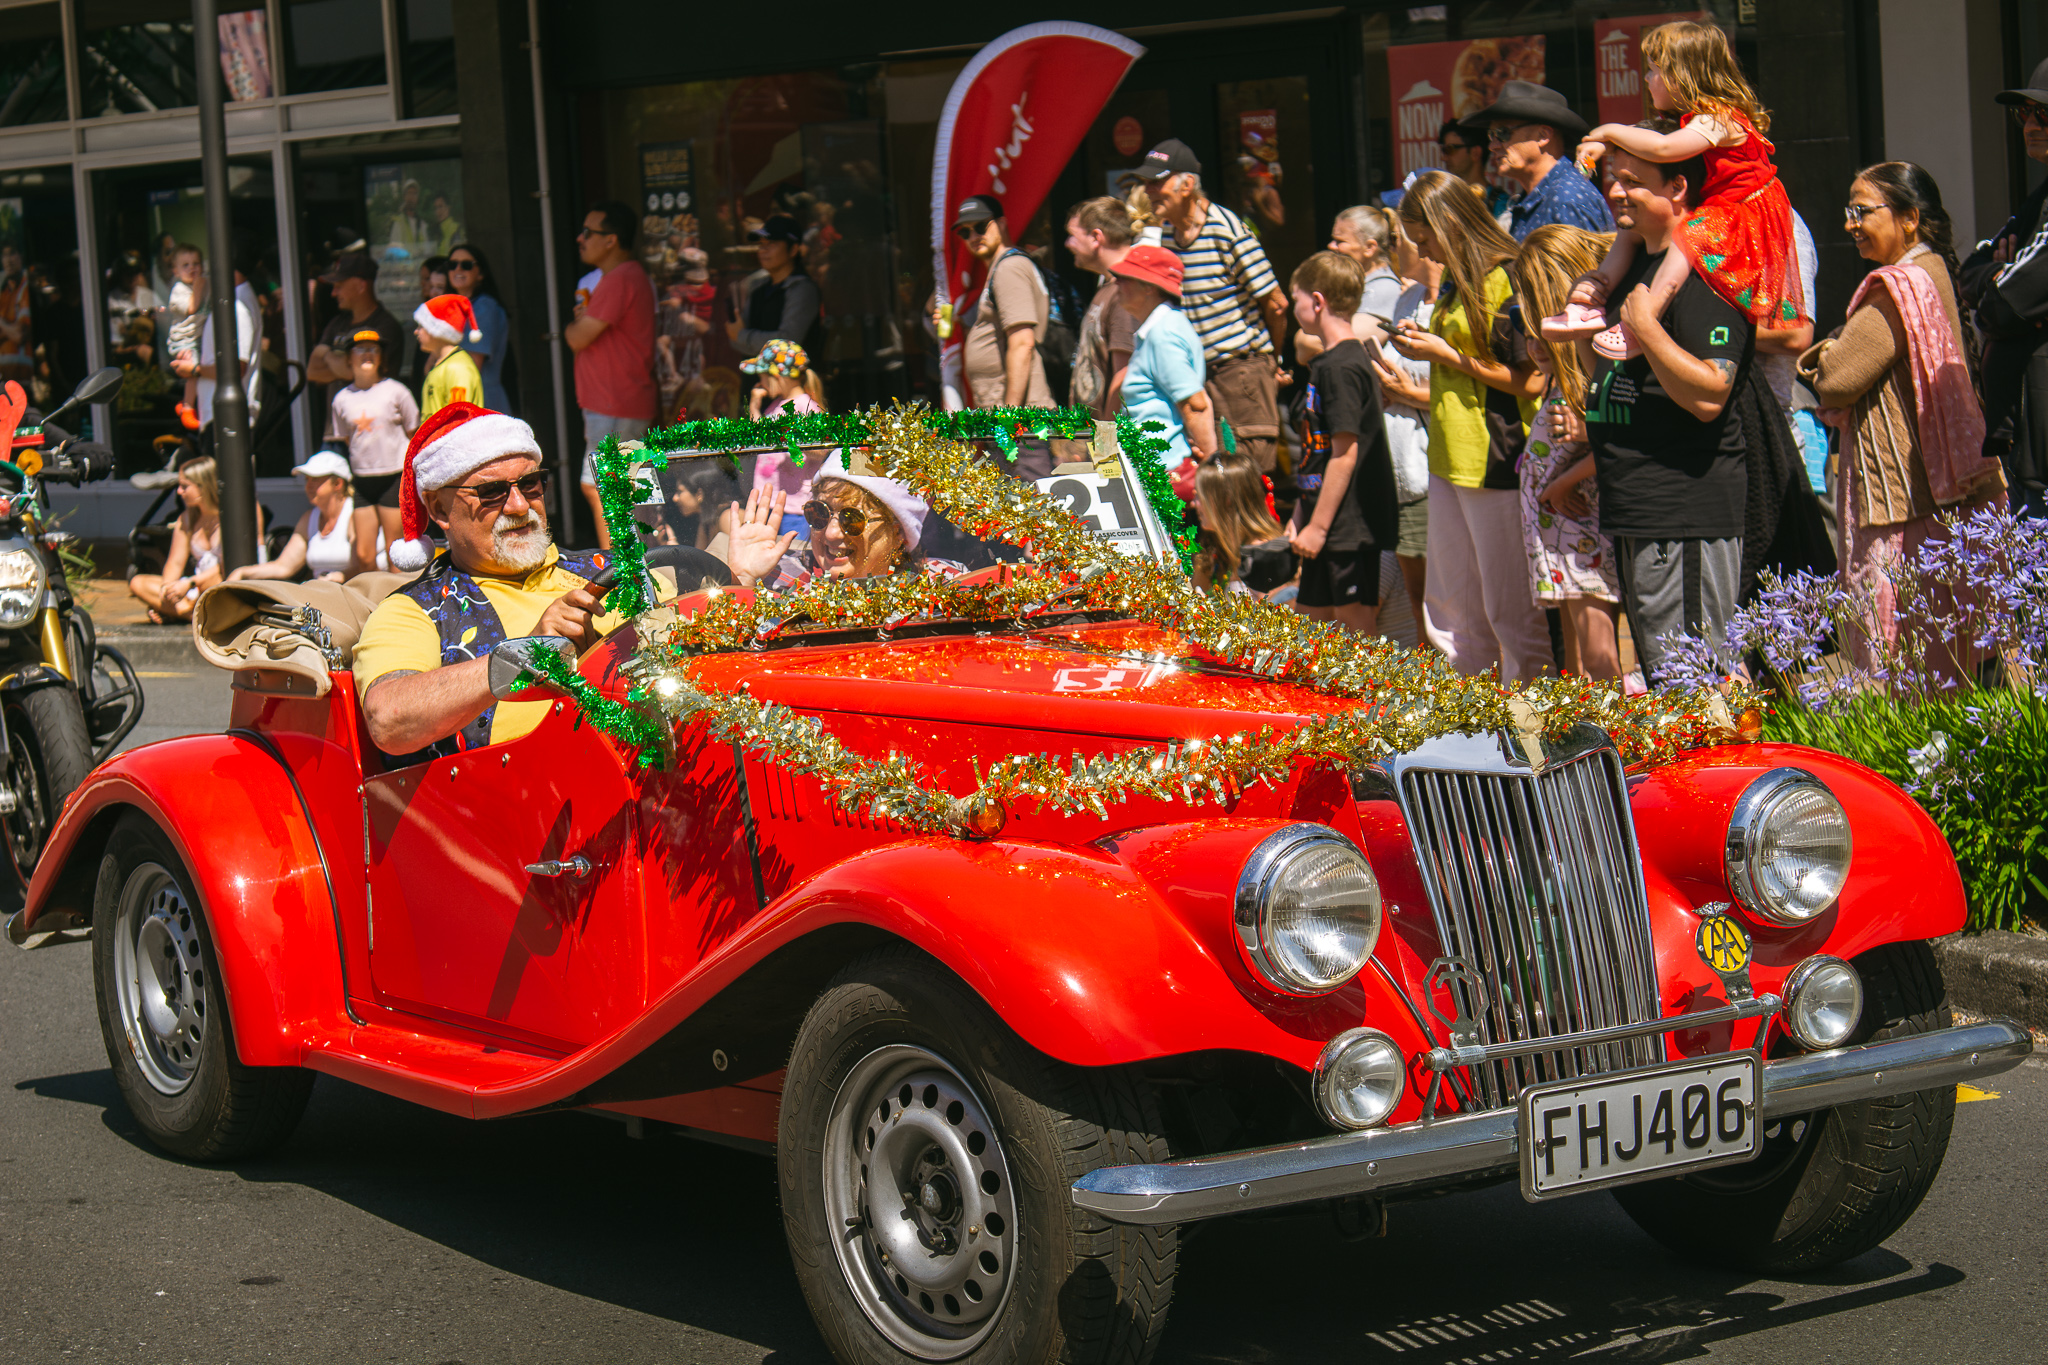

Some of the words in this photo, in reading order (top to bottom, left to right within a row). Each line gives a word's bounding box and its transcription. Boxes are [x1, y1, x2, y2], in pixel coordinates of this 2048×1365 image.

[1600, 44, 1629, 71] THE
[1601, 69, 1640, 97] LIMO
[1399, 102, 1444, 140] NOW
[1400, 141, 1447, 178] UND
[1049, 478, 1139, 531] 21
[1543, 1077, 1746, 1176] FHJ406
